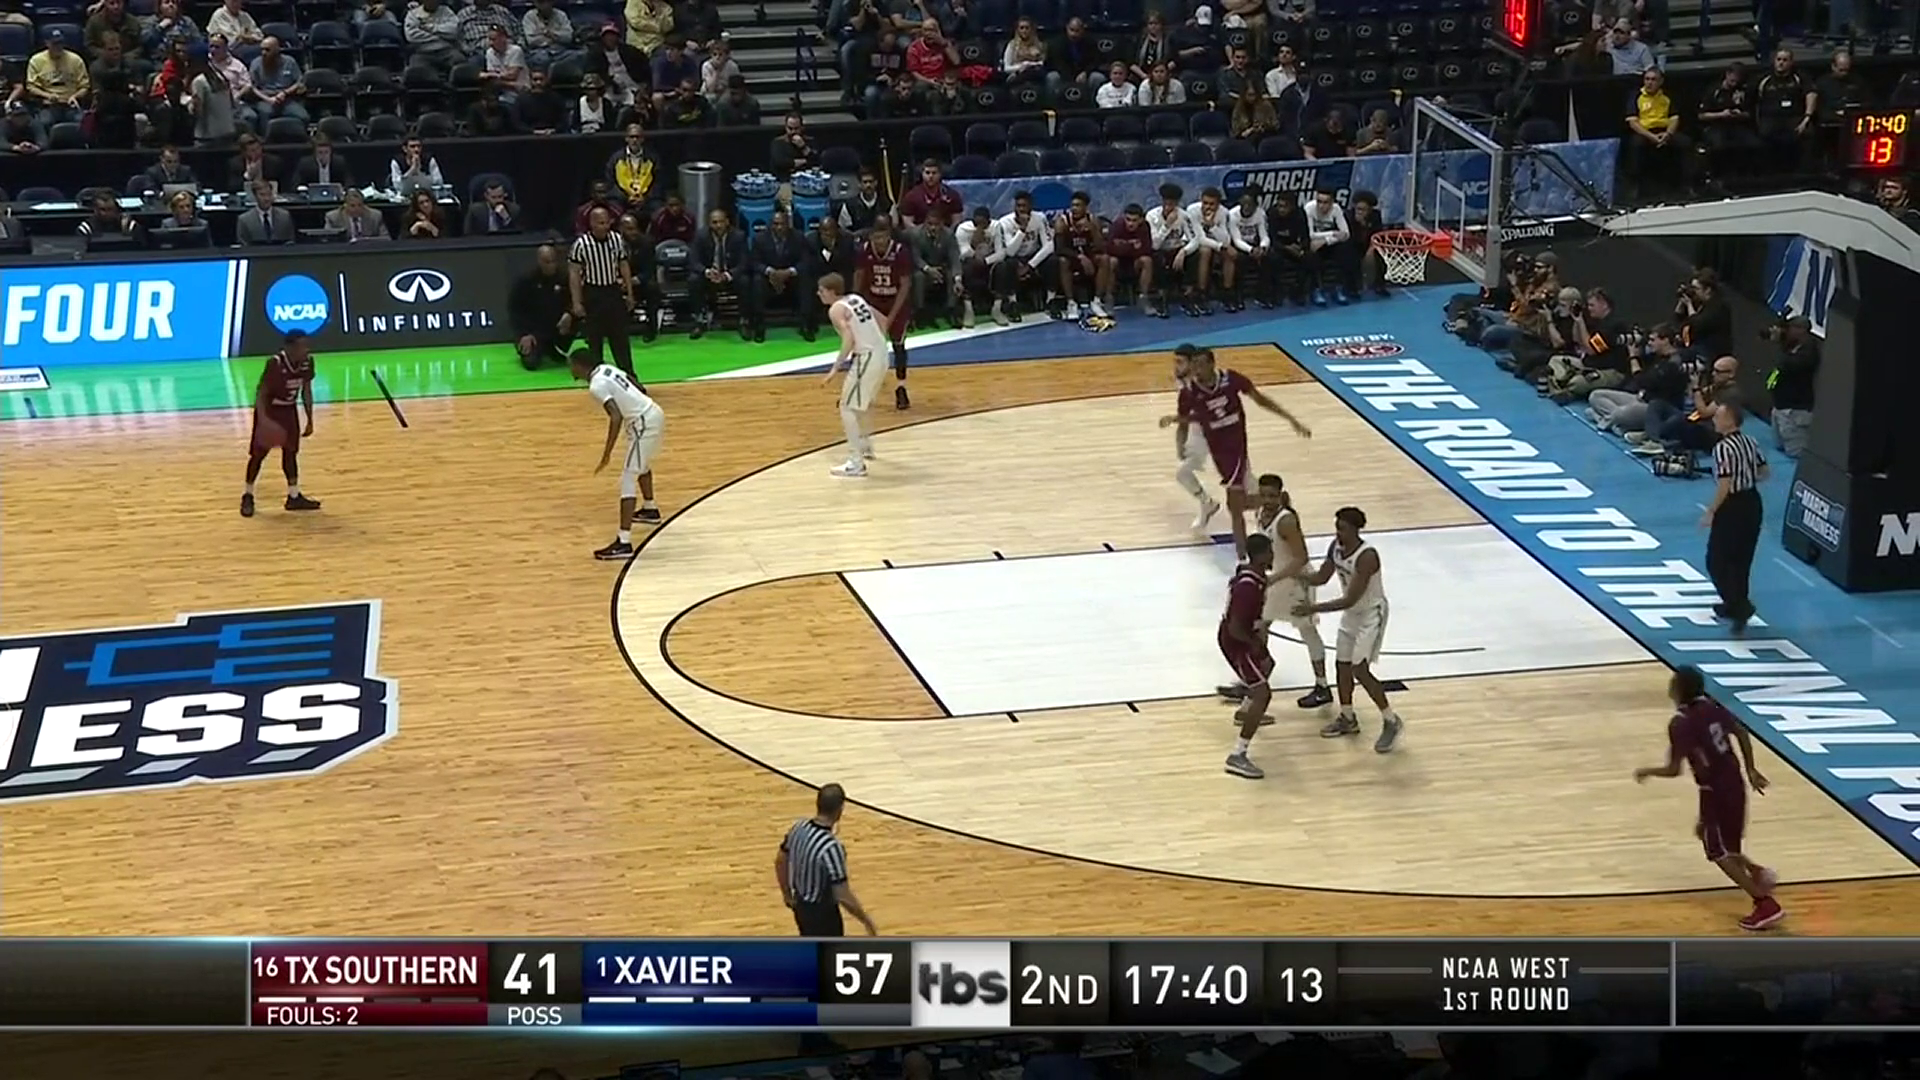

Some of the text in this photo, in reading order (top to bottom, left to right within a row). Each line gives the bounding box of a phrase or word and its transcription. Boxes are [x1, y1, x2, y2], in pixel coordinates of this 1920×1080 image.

[1857, 114, 1907, 134] 17:40
[1870, 137, 1893, 163] 13
[1246, 168, 1317, 193] MARCH
[1501, 223, 1555, 242] SPALDING
[874, 275, 891, 287] 33
[3, 280, 177, 345] FOUR
[273, 303, 328, 321] NCAA
[357, 310, 493, 333] INFINITI
[1301, 333, 1396, 347] HOSTED BY:
[1801, 489, 1831, 520] MARCH
[1803, 508, 1841, 546] MADNESS
[1324, 358, 1920, 754] THE ROAD TO THE FINAL
[0, 682, 361, 770] ESS
